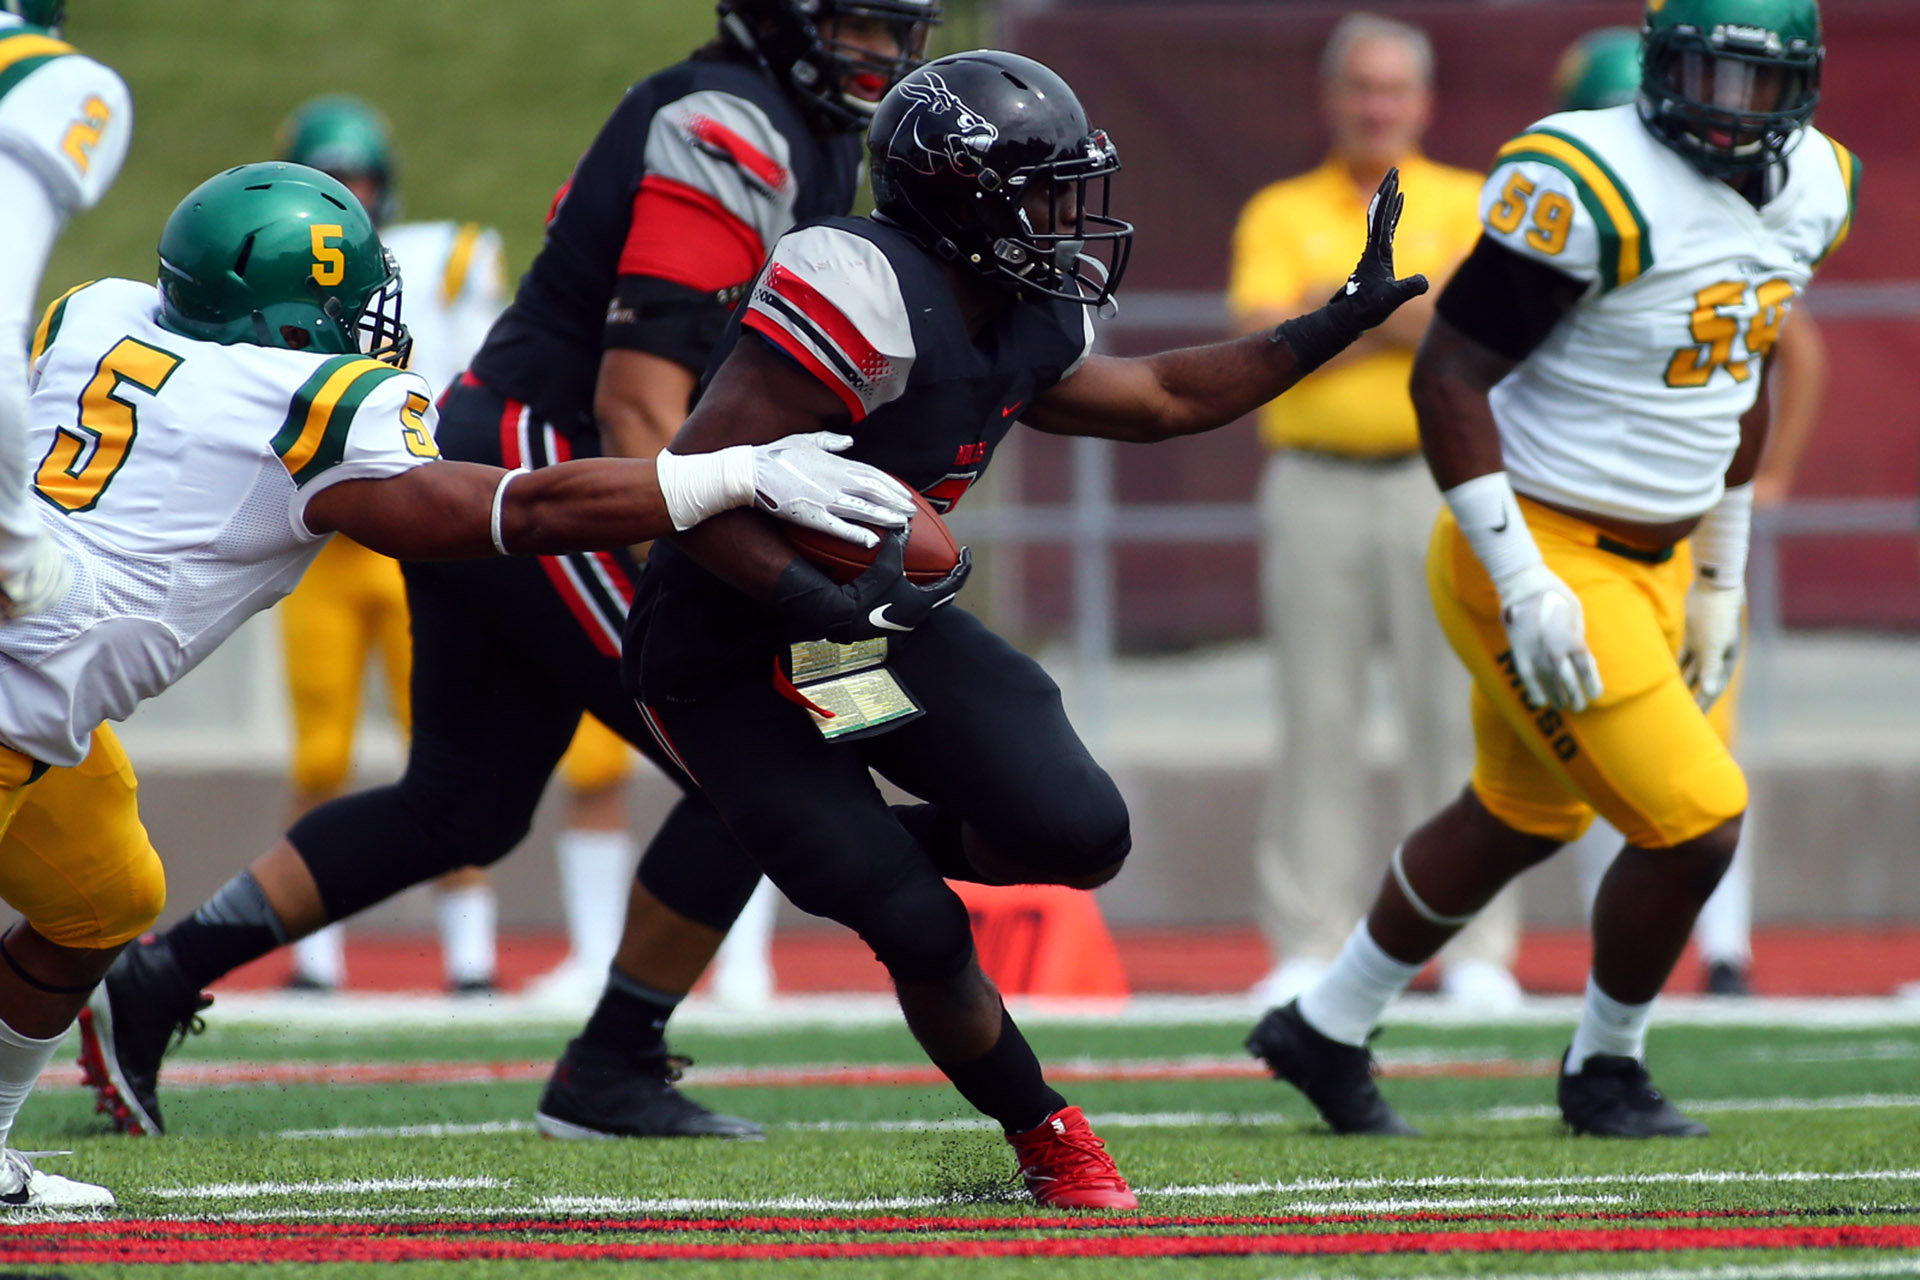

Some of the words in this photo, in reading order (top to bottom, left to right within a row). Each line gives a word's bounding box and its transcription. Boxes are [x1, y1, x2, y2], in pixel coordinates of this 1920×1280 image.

[62, 95, 110, 177] 2
[310, 224, 345, 286] 5
[1488, 170, 1574, 256] 59
[1663, 277, 1794, 388] 59
[28, 335, 186, 516] 5
[400, 390, 441, 459] 5
